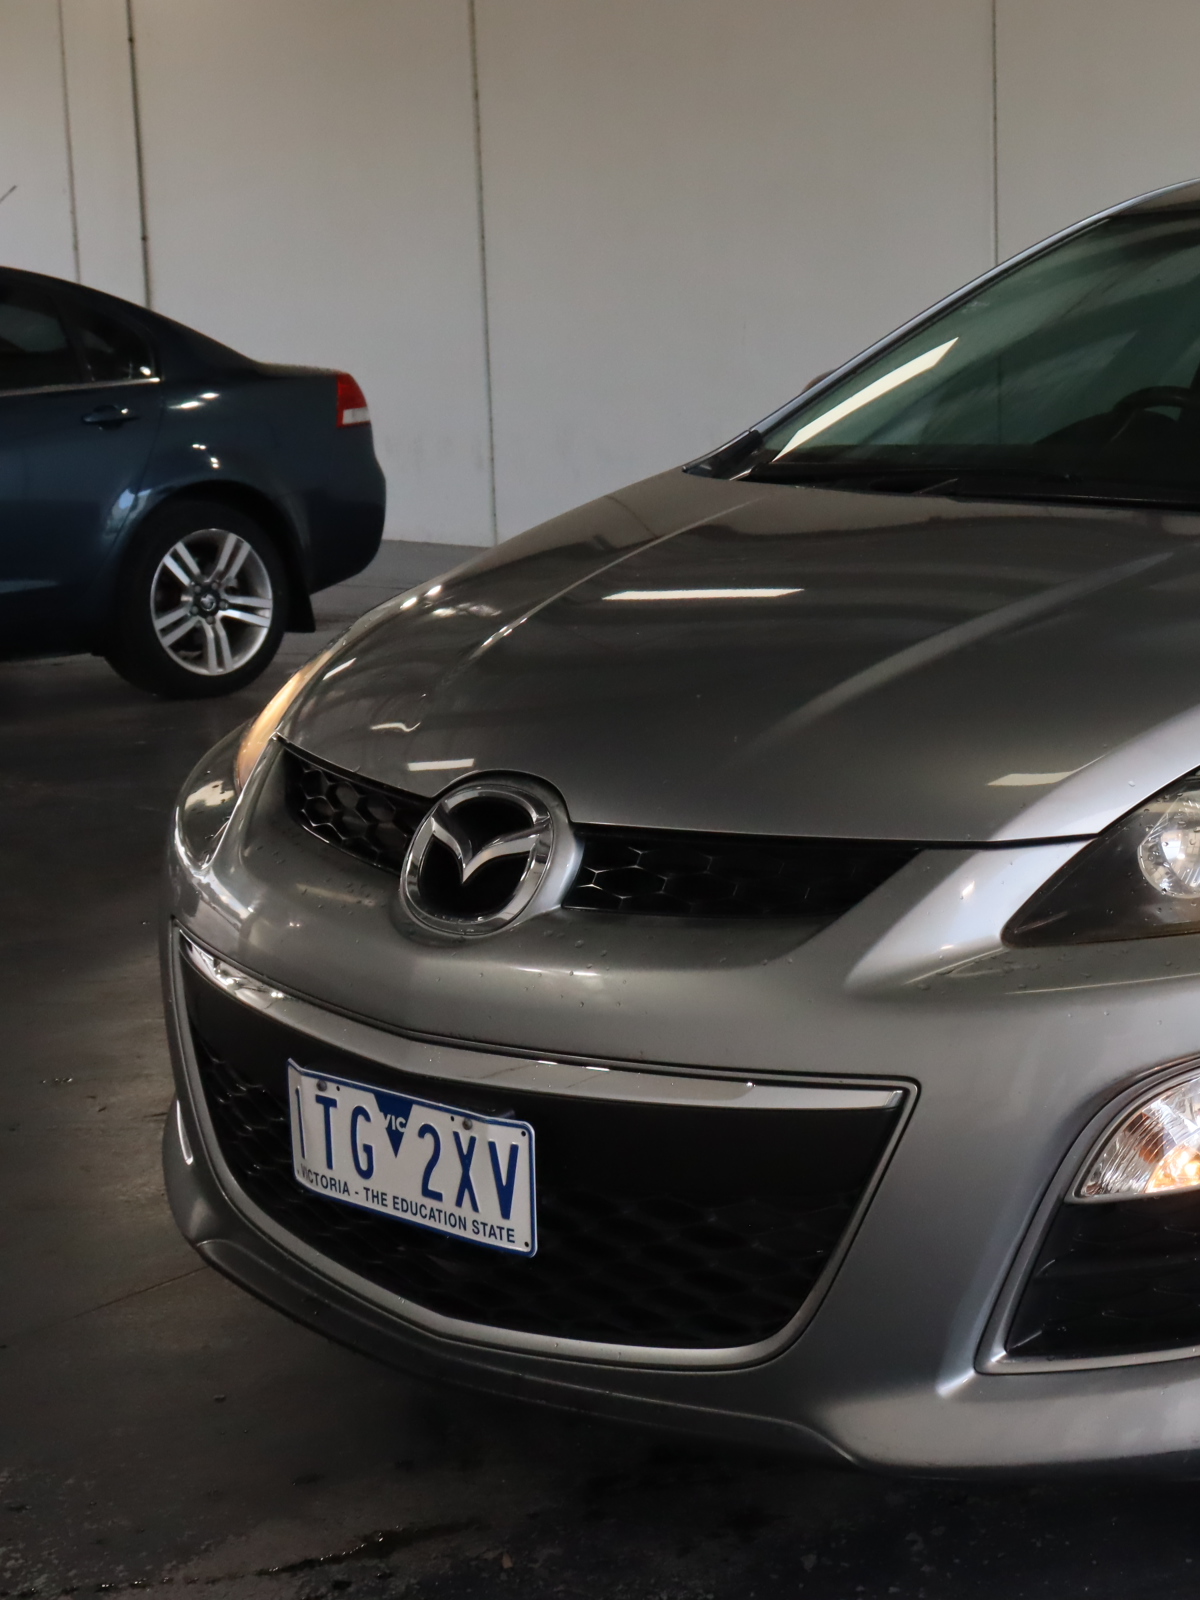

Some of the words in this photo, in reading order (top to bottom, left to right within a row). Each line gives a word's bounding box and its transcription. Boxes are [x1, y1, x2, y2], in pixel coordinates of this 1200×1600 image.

[380, 1111, 406, 1133] VIC
[300, 1163, 351, 1196] VICTORIA
[363, 1186, 388, 1207] THE
[392, 1195, 467, 1231] EDUCATION
[472, 1219, 516, 1244] STATE
[417, 1123, 519, 1220] 2XV
